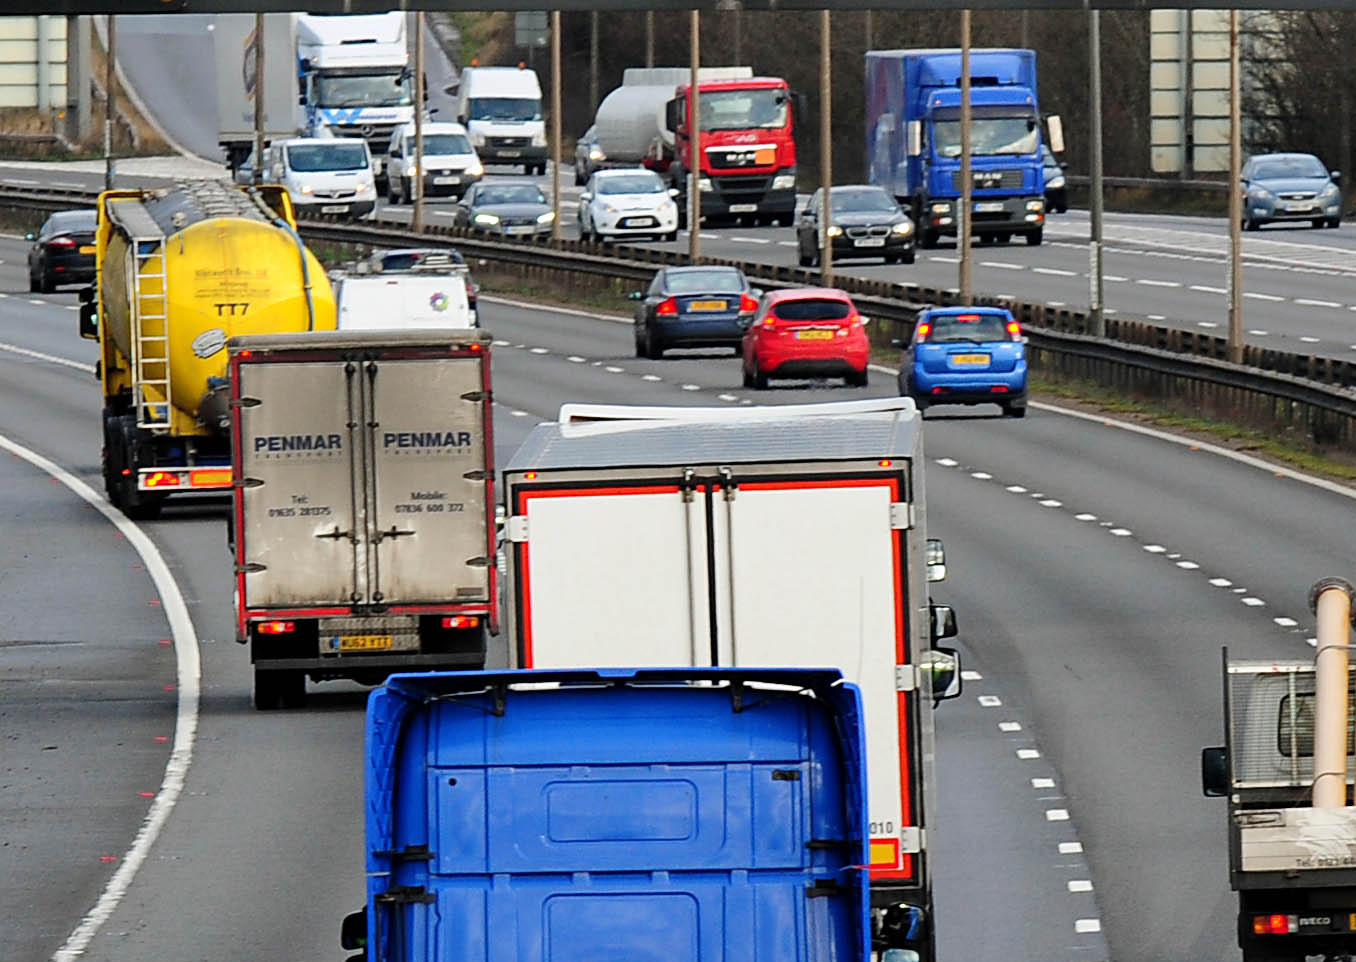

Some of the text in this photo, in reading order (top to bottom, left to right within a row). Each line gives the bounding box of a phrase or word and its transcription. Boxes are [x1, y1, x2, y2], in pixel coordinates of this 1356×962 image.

[214, 303, 249, 317] TT7
[255, 434, 342, 451] PENMAR
[383, 432, 471, 449] PENMAR
[1300, 916, 1331, 926] IVECO
